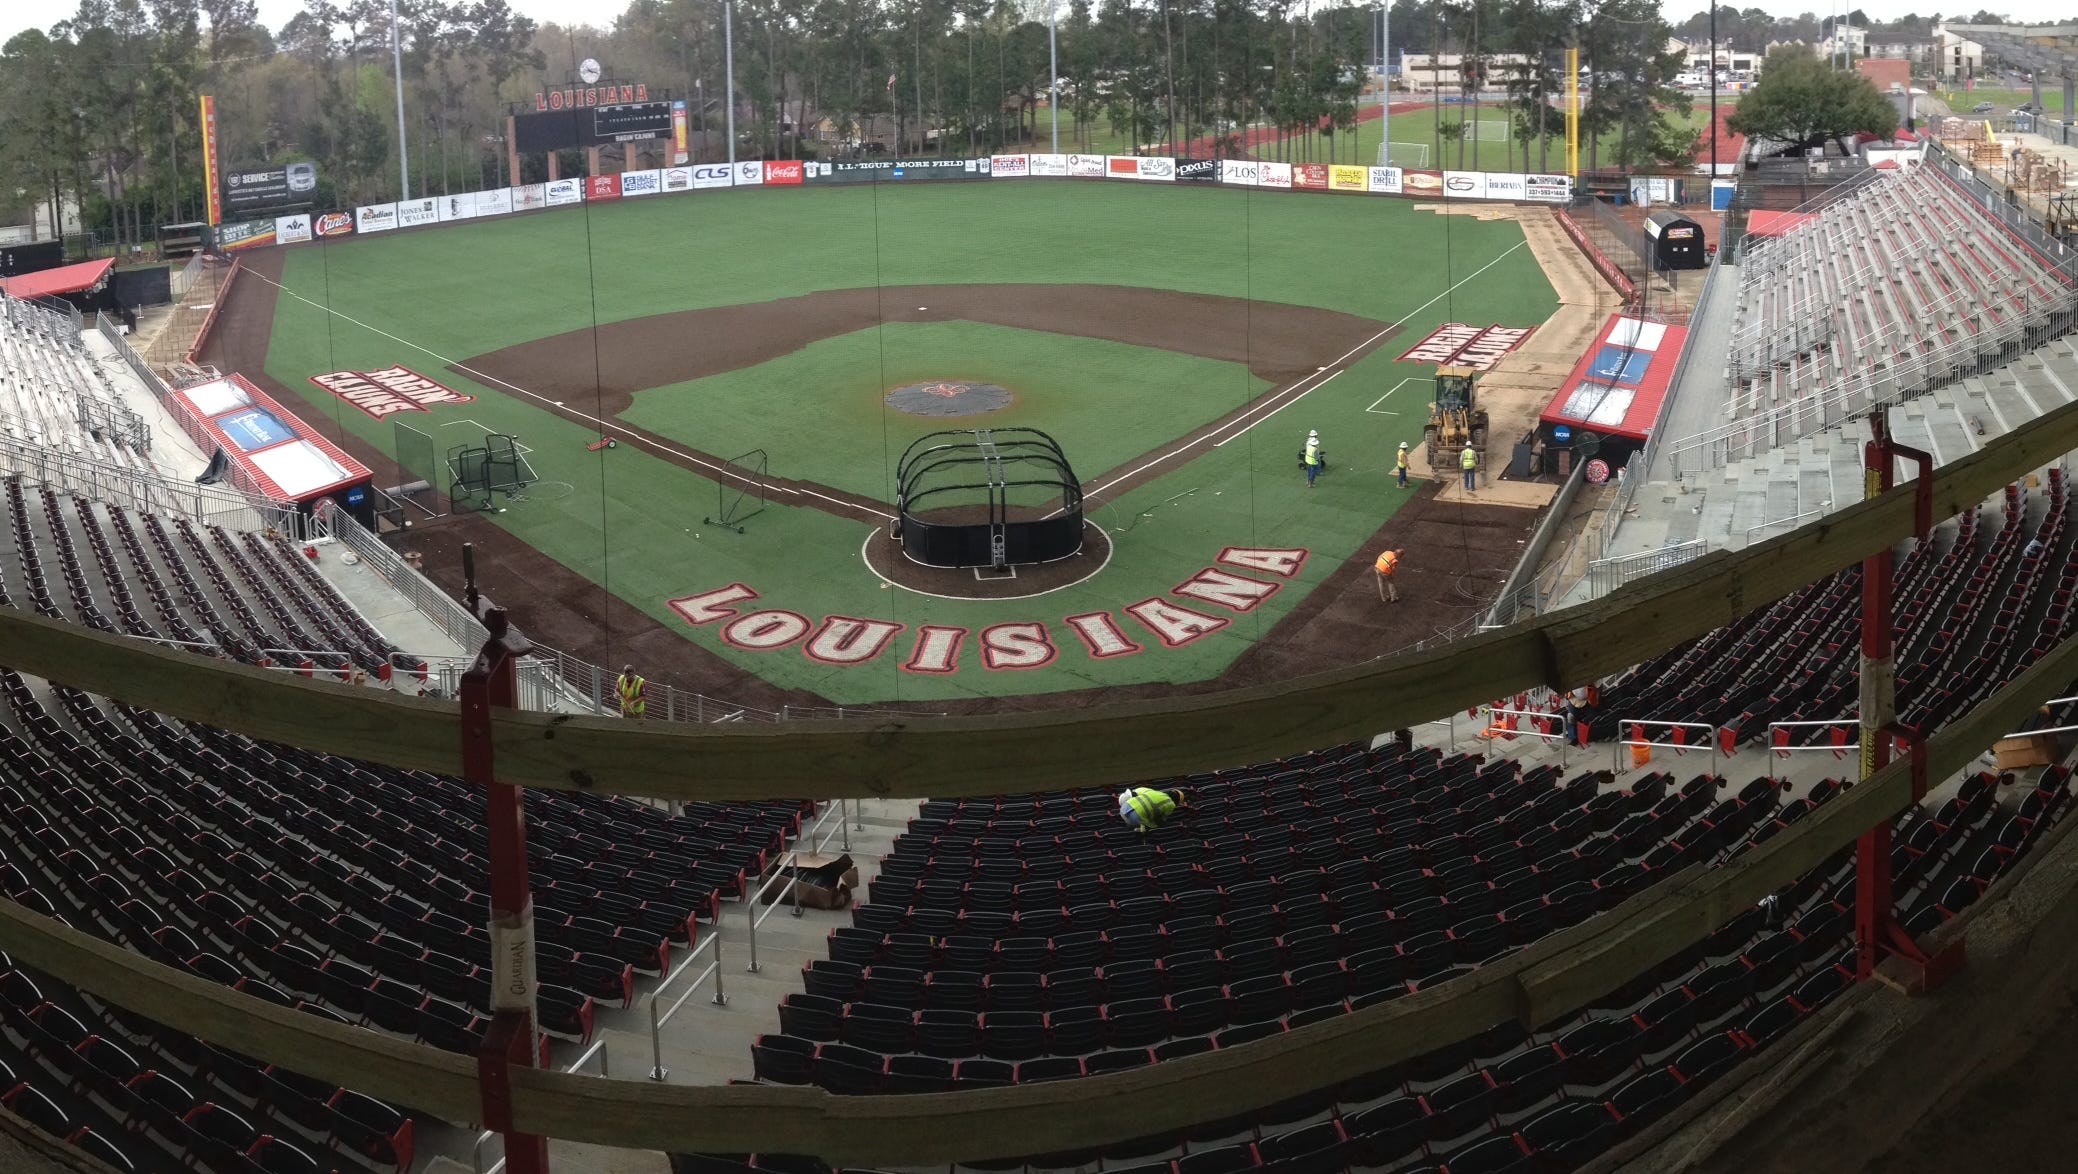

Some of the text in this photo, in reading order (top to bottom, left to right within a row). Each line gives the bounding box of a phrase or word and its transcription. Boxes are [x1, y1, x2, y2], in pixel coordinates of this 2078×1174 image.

[536, 84, 648, 111] LOUISIANA
[1235, 167, 1257, 179] LOS
[223, 223, 250, 234] SHOP
[315, 212, 352, 235] Cane's
[405, 213, 435, 223] WALKER
[1446, 324, 1535, 371] CAJUNS
[309, 370, 424, 421] CAJUNS
[666, 547, 1310, 673] LOUISIANA
[510, 940, 527, 996] GUARDIAN
